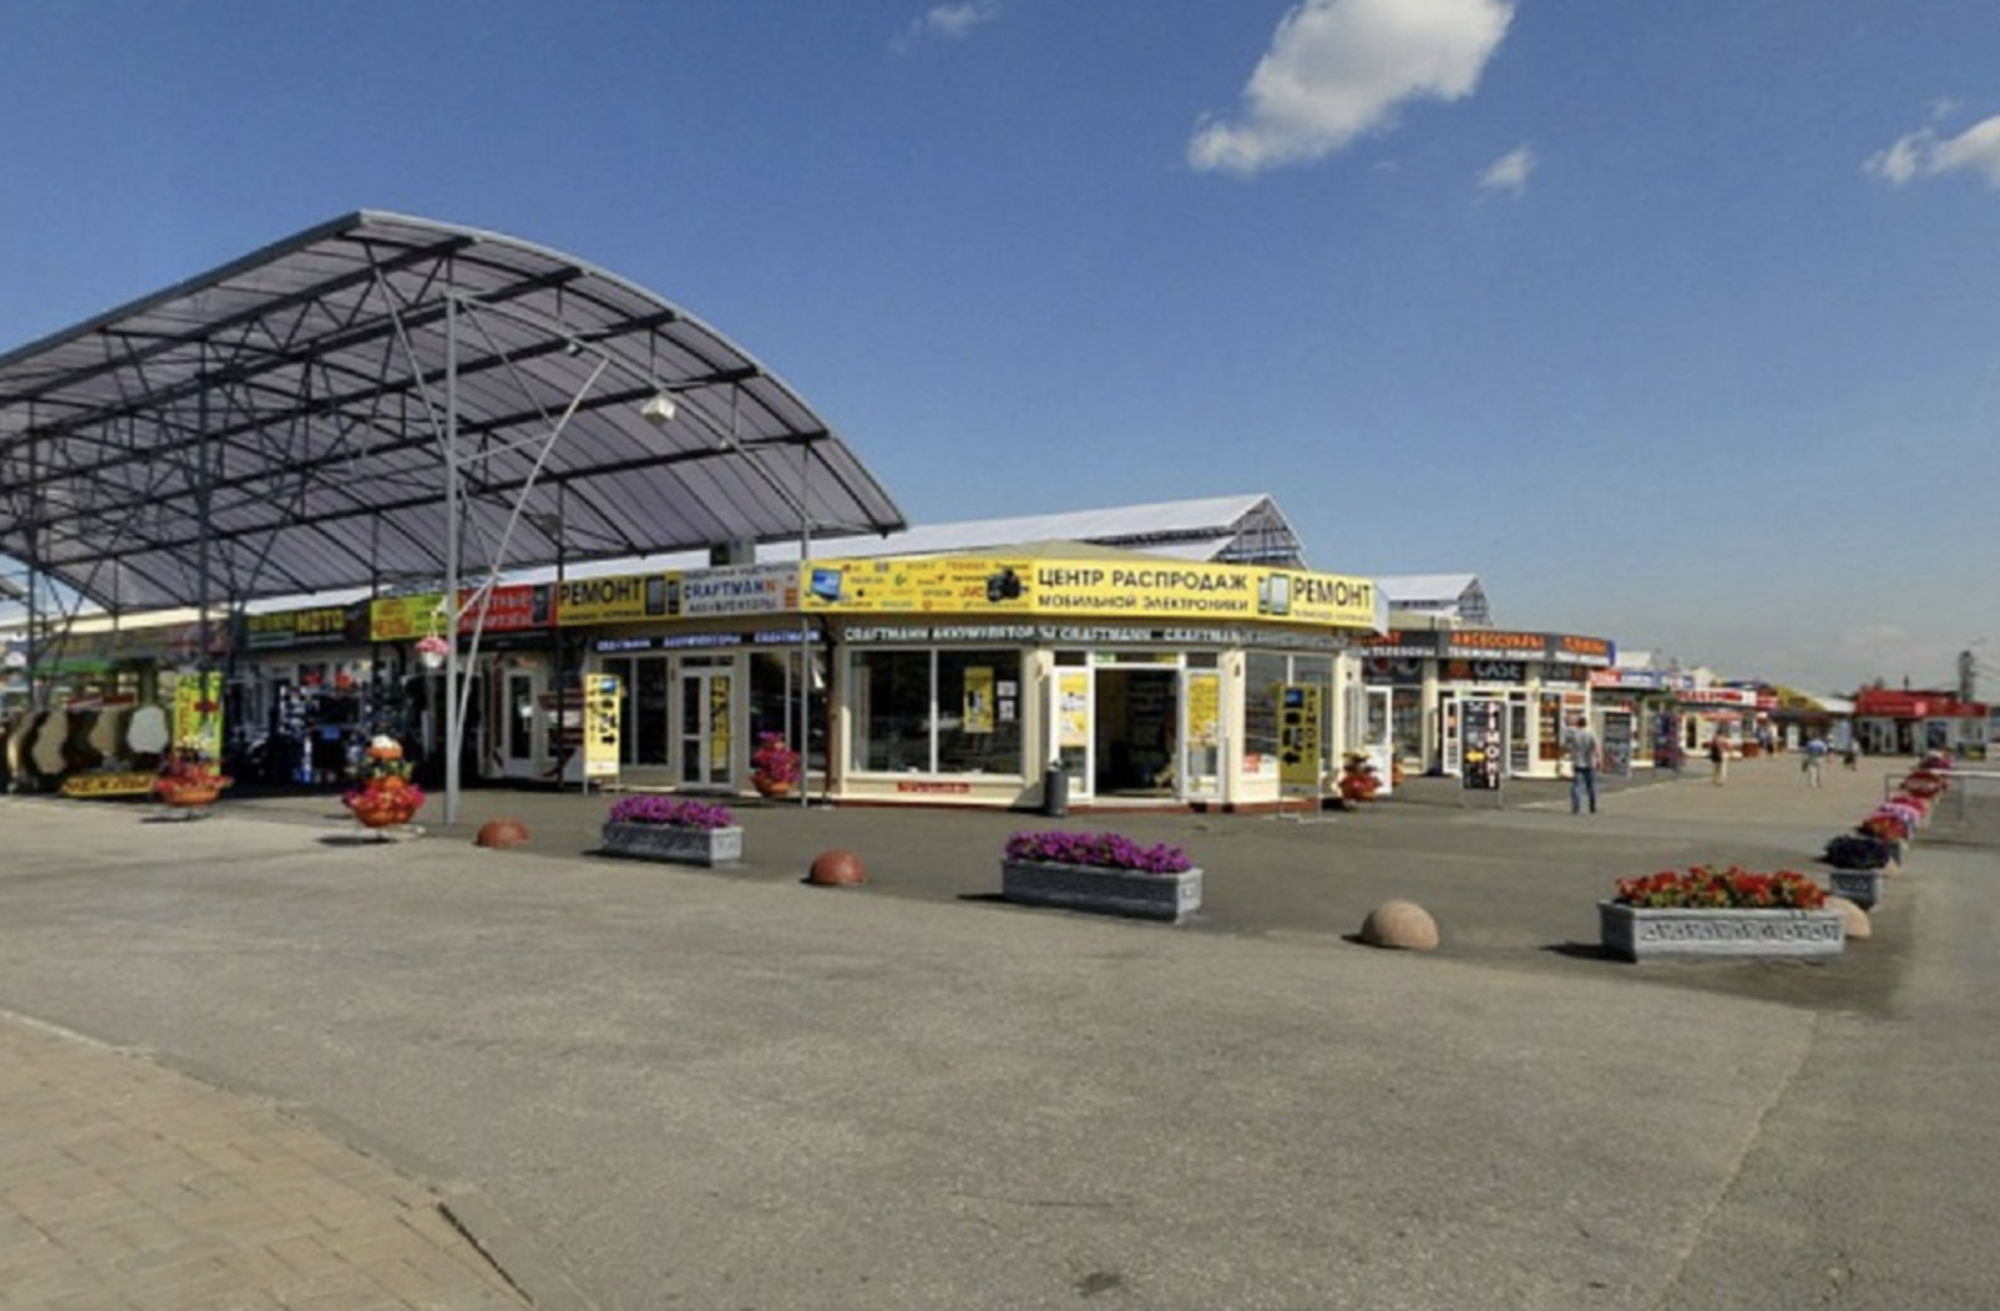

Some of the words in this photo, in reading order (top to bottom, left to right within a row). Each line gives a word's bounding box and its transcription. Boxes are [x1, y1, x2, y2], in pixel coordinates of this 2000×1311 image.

[559, 576, 641, 607] РЕМОНТ
[1038, 567, 1104, 590] ЦЕНТР
[1112, 569, 1248, 593] РАСПРОДАЖ
[1292, 575, 1370, 609] РЕМОНТ
[1038, 592, 1136, 611] МОБИЛЬНОЙ
[1143, 595, 1248, 612] ЭЛЕКТРОНИКИ
